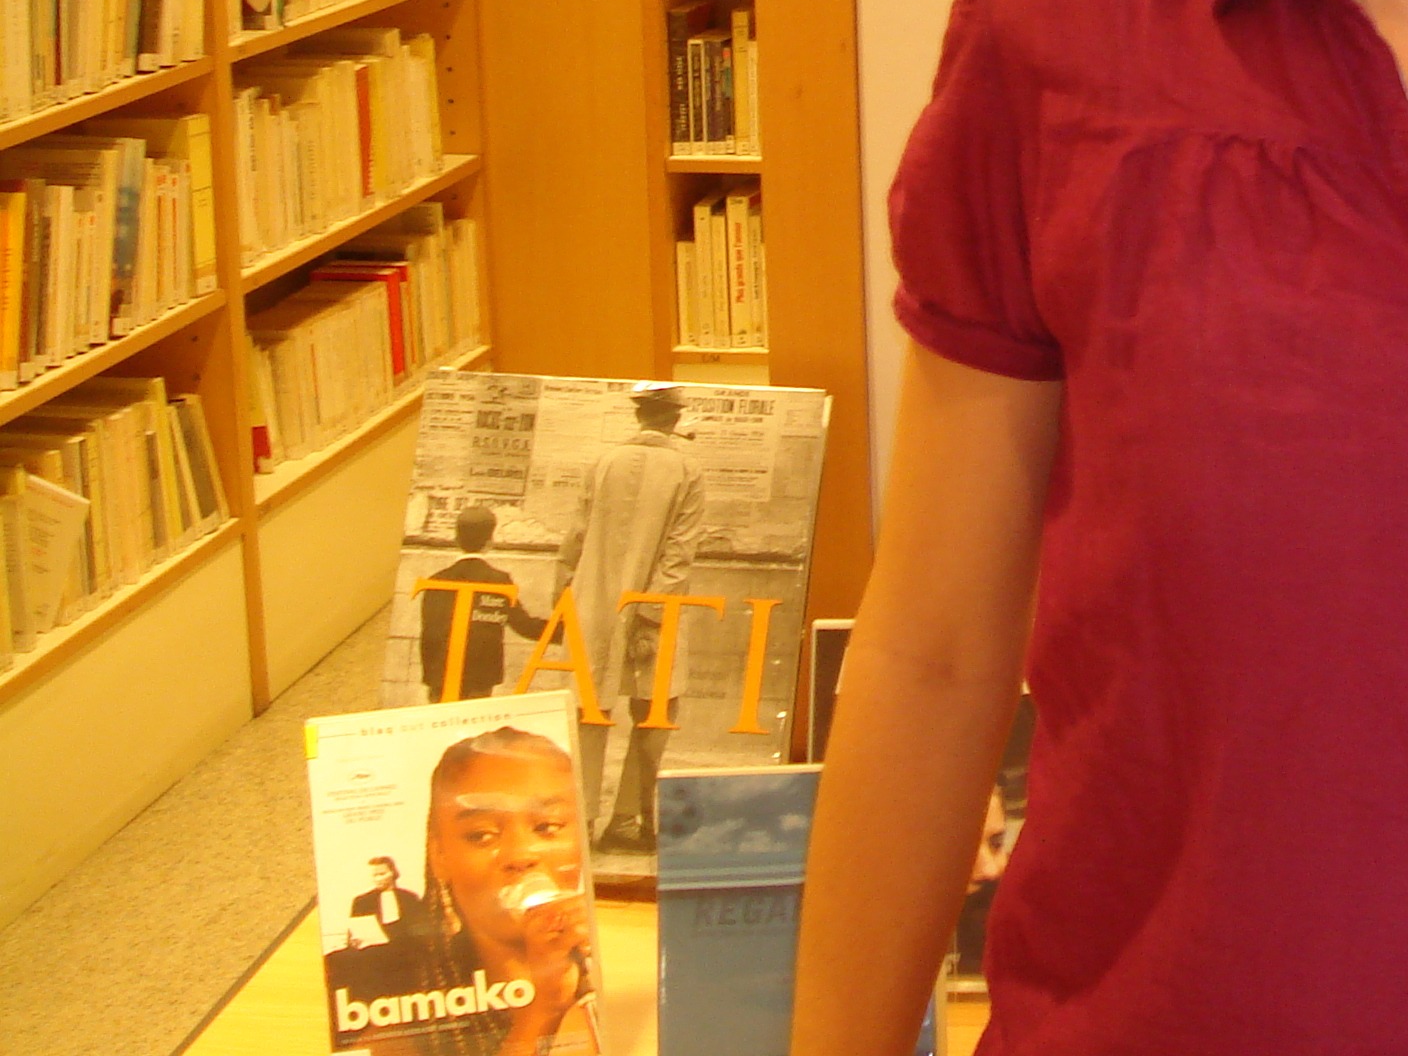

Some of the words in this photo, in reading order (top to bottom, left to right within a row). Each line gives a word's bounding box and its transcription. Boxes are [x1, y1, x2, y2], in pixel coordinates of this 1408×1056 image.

[411, 576, 783, 735] TATI
[431, 712, 511, 729] collection
[335, 969, 536, 1032] bamako
